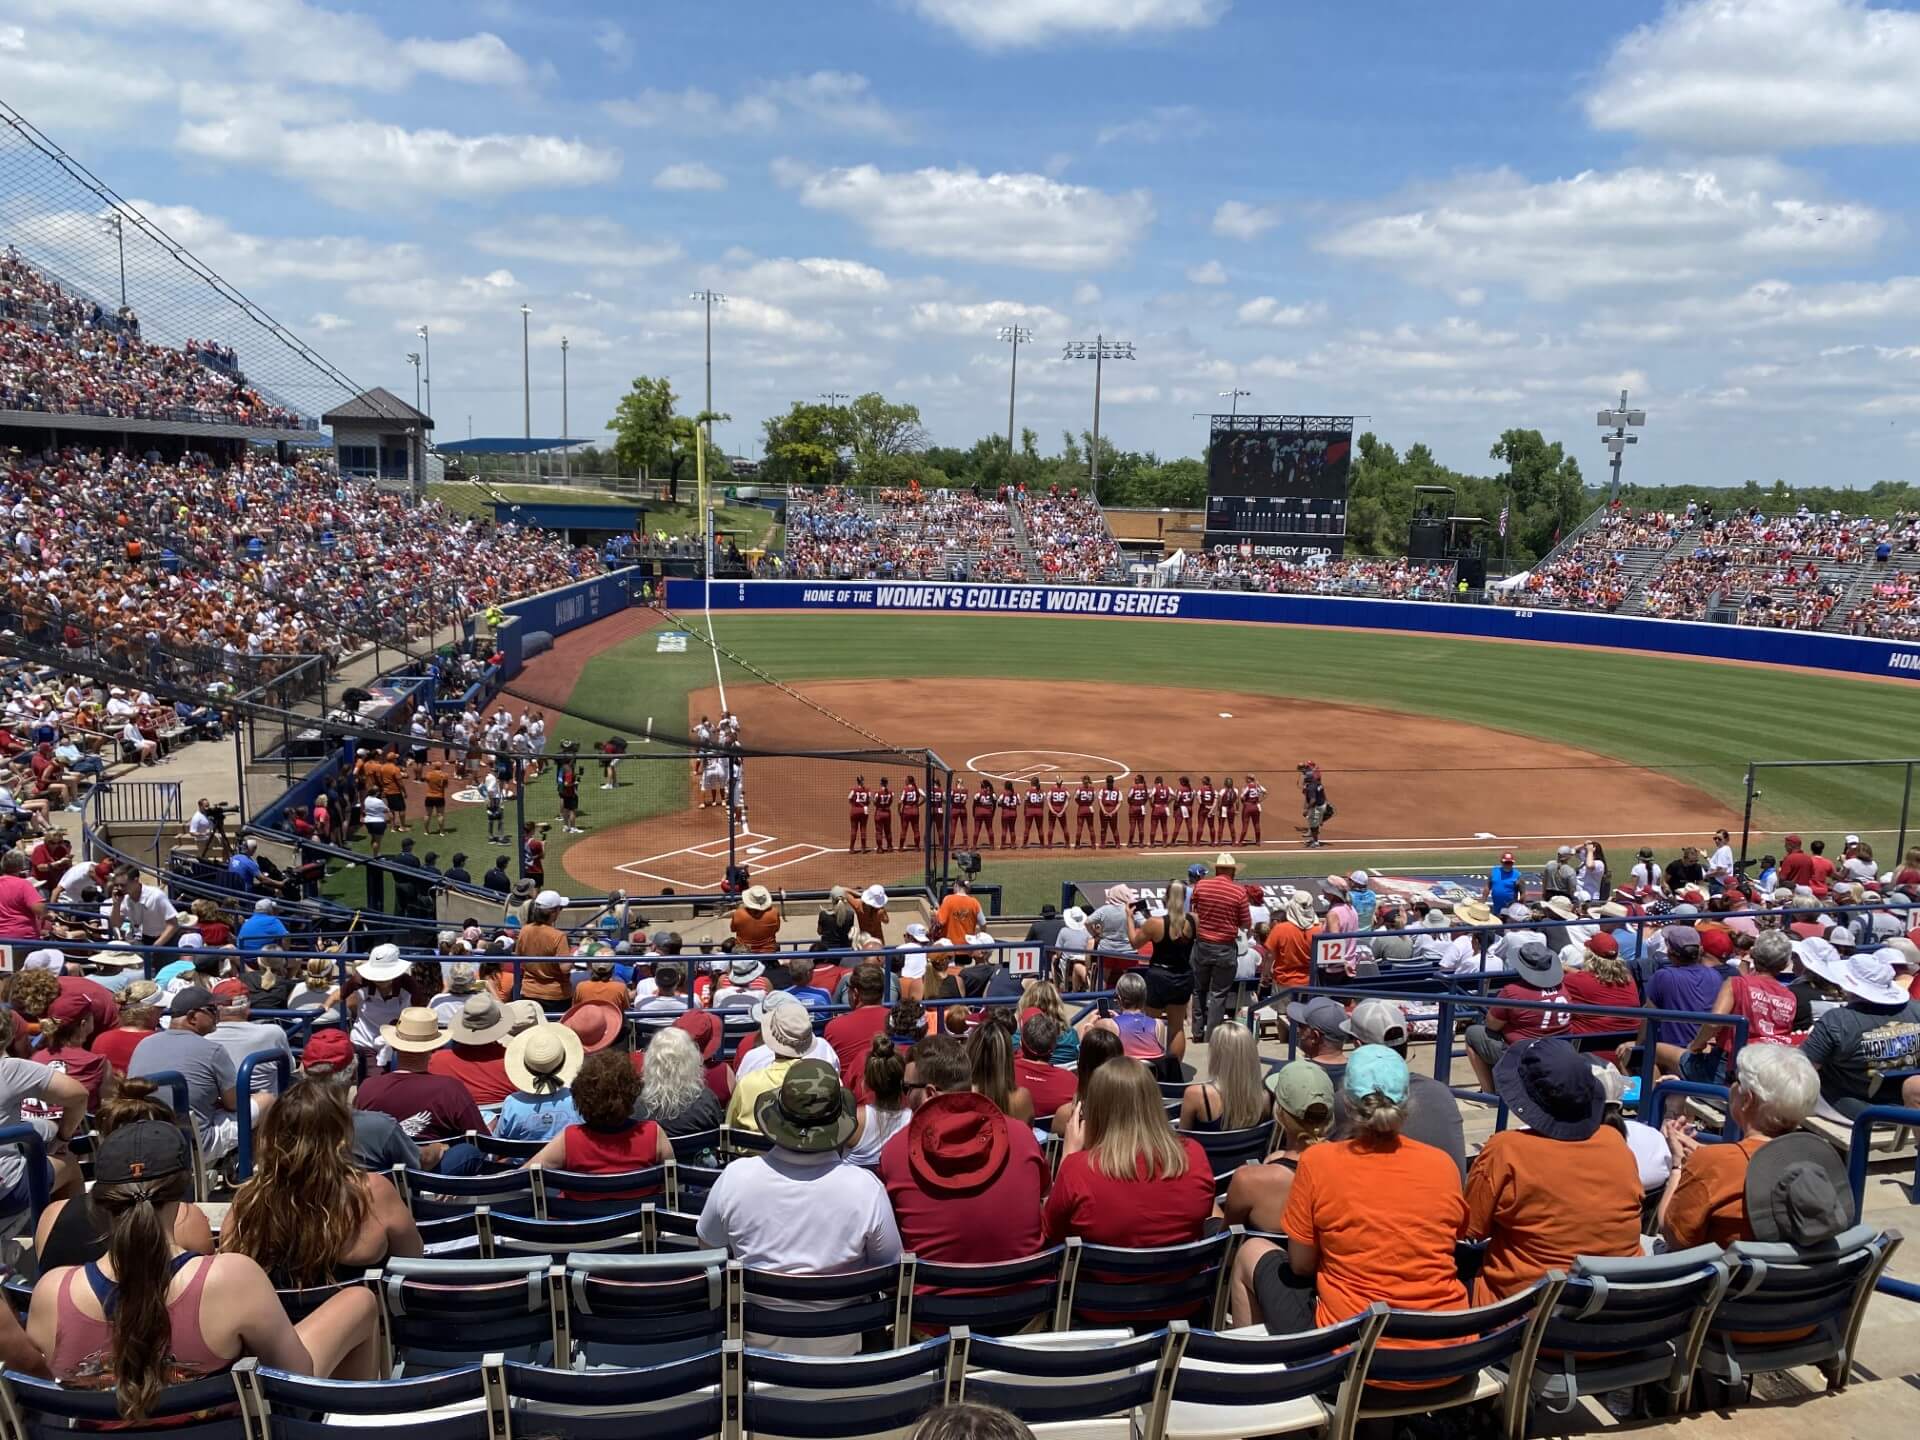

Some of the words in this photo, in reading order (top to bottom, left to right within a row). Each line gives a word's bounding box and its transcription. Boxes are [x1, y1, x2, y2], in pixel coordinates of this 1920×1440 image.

[1214, 544, 1238, 554] OGE
[1254, 546, 1299, 556] ENERGY
[803, 589, 834, 602] HOME
[836, 590, 850, 602] OF
[853, 590, 872, 602] THE
[876, 587, 964, 608] WOMEN'S
[966, 589, 1044, 610] COLLEGE
[1046, 591, 1112, 612] WORLD
[1113, 594, 1180, 614] SERIES
[1322, 943, 1342, 960] 12
[1017, 952, 1032, 970] 11
